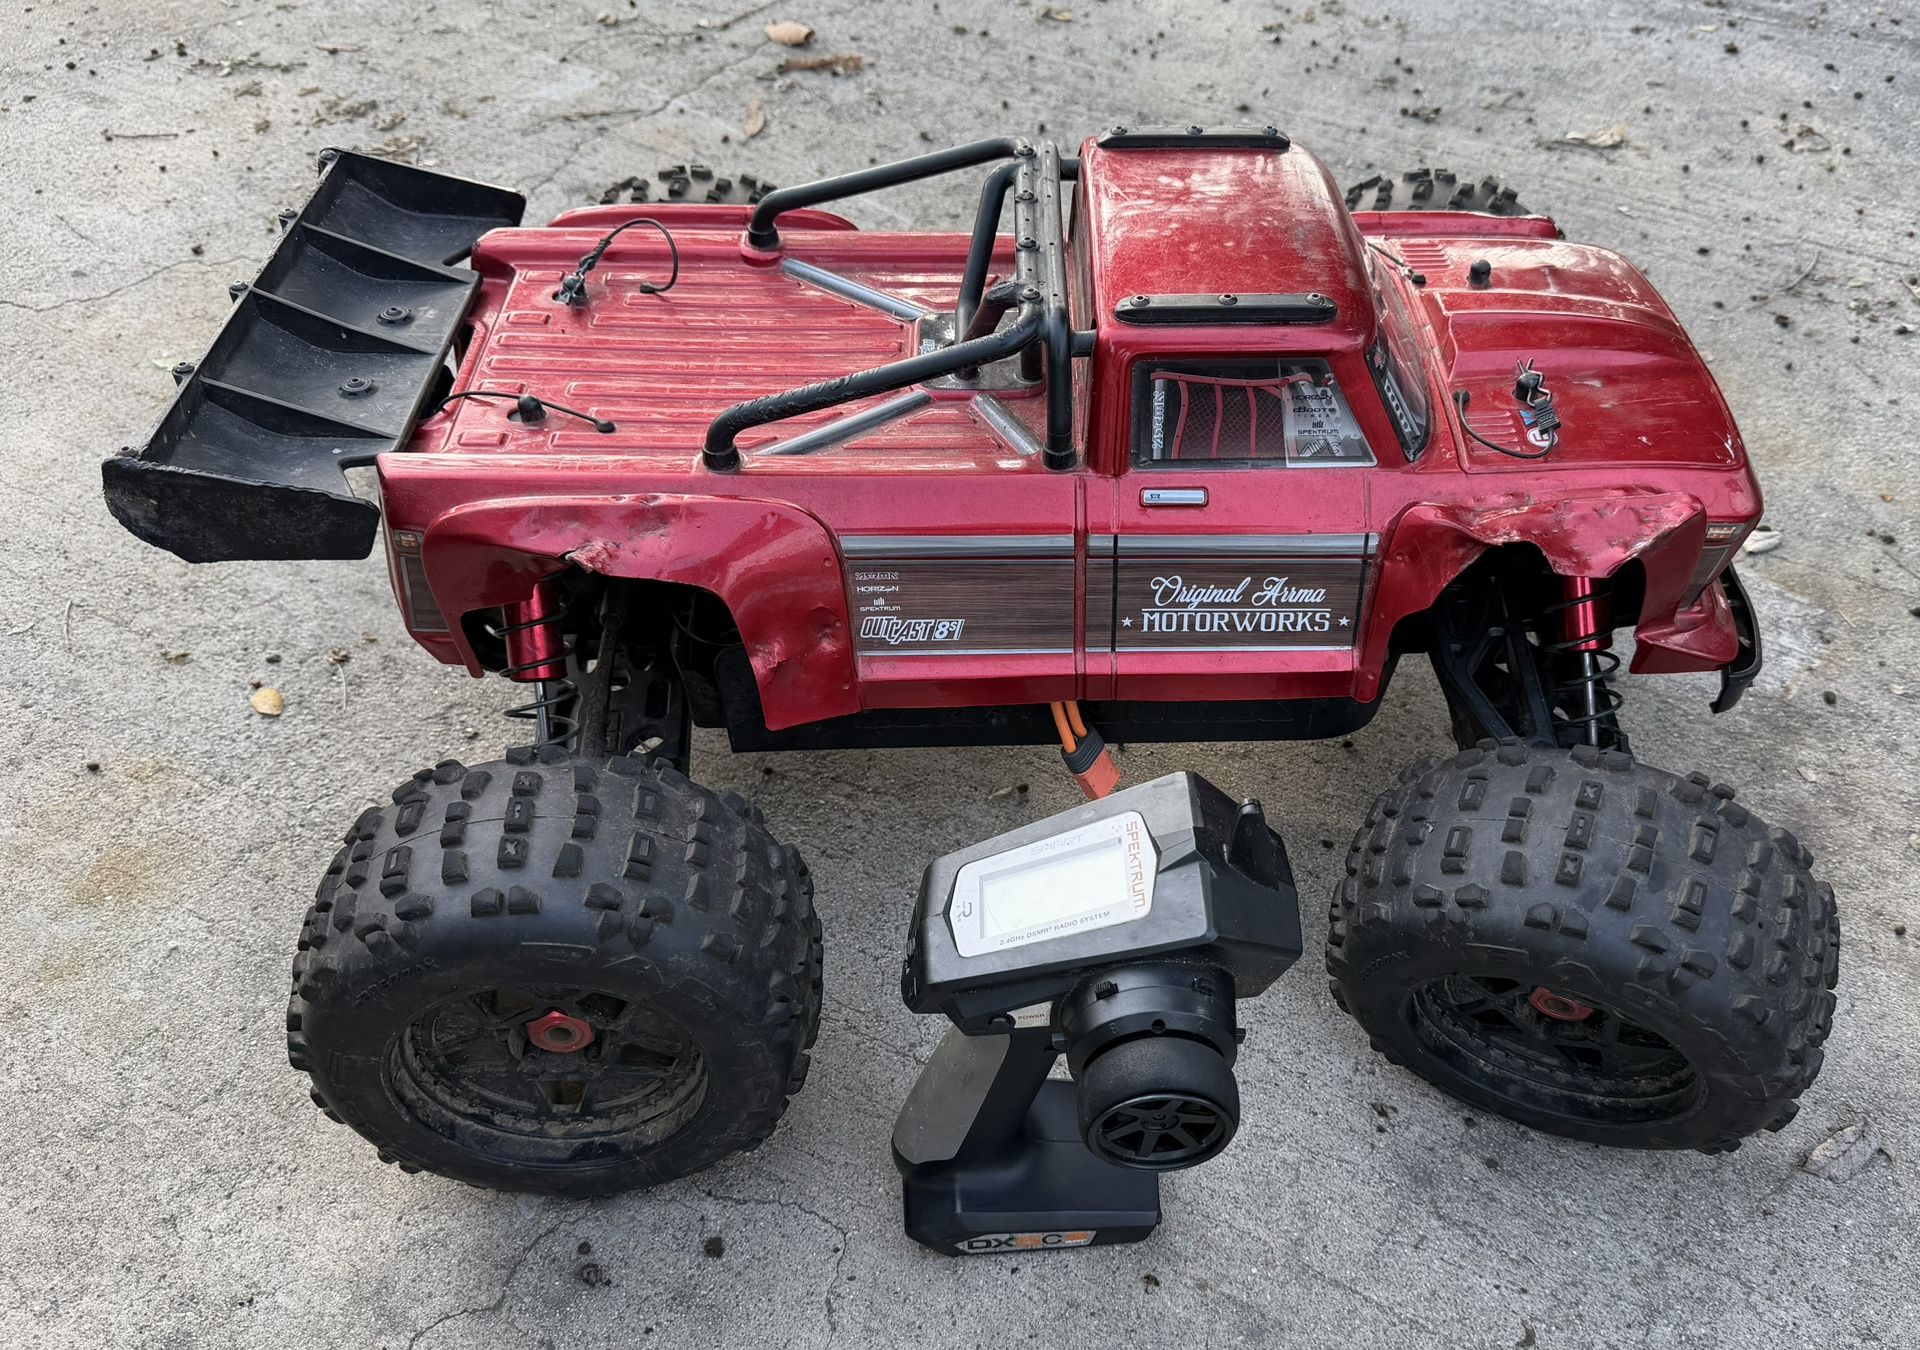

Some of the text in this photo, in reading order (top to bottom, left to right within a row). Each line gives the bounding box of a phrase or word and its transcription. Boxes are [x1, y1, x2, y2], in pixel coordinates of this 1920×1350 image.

[1150, 575, 1326, 609] Original Arrma
[860, 616, 934, 644] OUTCAST
[1141, 612, 1331, 632] MOTORWORKS
[1126, 821, 1146, 911] SPEKTRUM
[999, 934, 1024, 945] 2.4GHz
[1054, 919, 1078, 931] RADIO
[1080, 910, 1110, 924] SYSTEM
